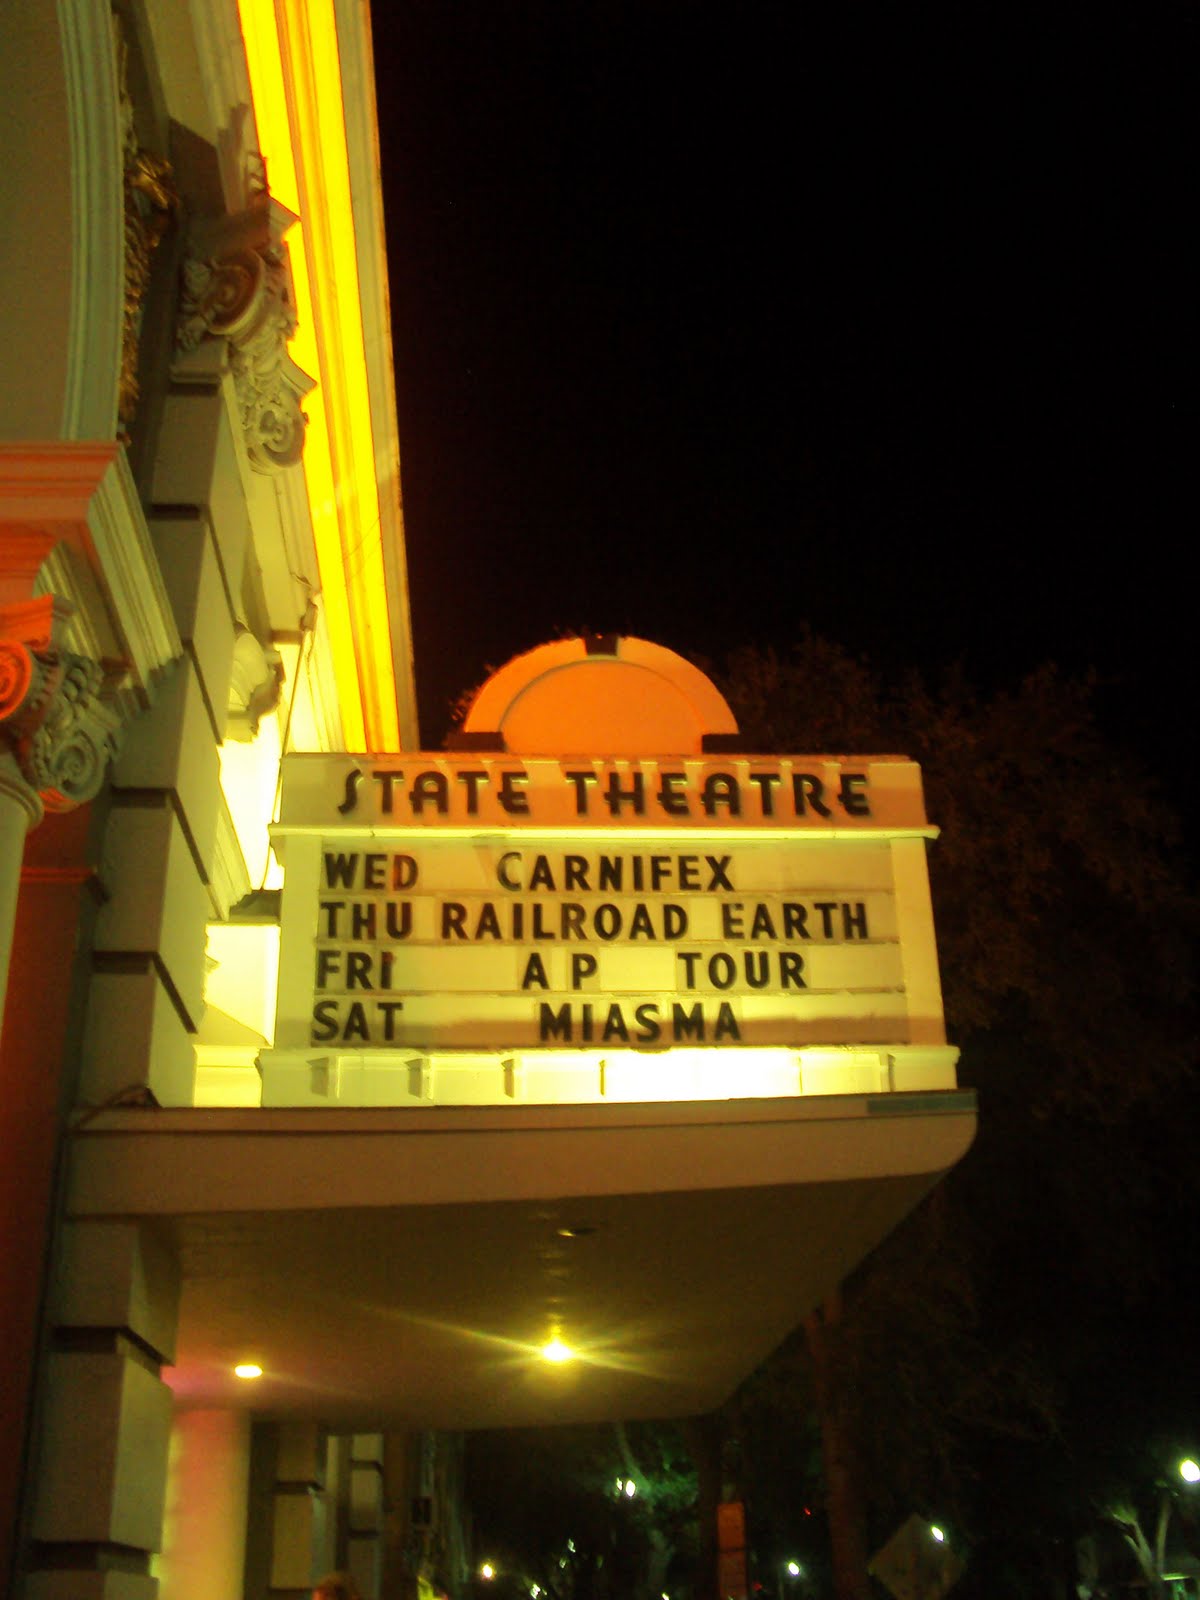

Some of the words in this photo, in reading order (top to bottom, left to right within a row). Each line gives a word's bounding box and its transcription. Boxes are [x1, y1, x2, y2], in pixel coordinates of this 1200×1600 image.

[338, 769, 531, 816] STATE
[566, 772, 871, 818] THEATRE
[324, 853, 420, 891] WED
[497, 852, 736, 892] CARNIFEX
[320, 902, 413, 940] THU
[442, 902, 689, 942] RAILROAD
[722, 902, 869, 940] EARTH
[316, 951, 393, 990] FRI
[678, 951, 808, 990] TOUR
[311, 1001, 403, 1042] SAT
[540, 1001, 743, 1042] MIASMA
